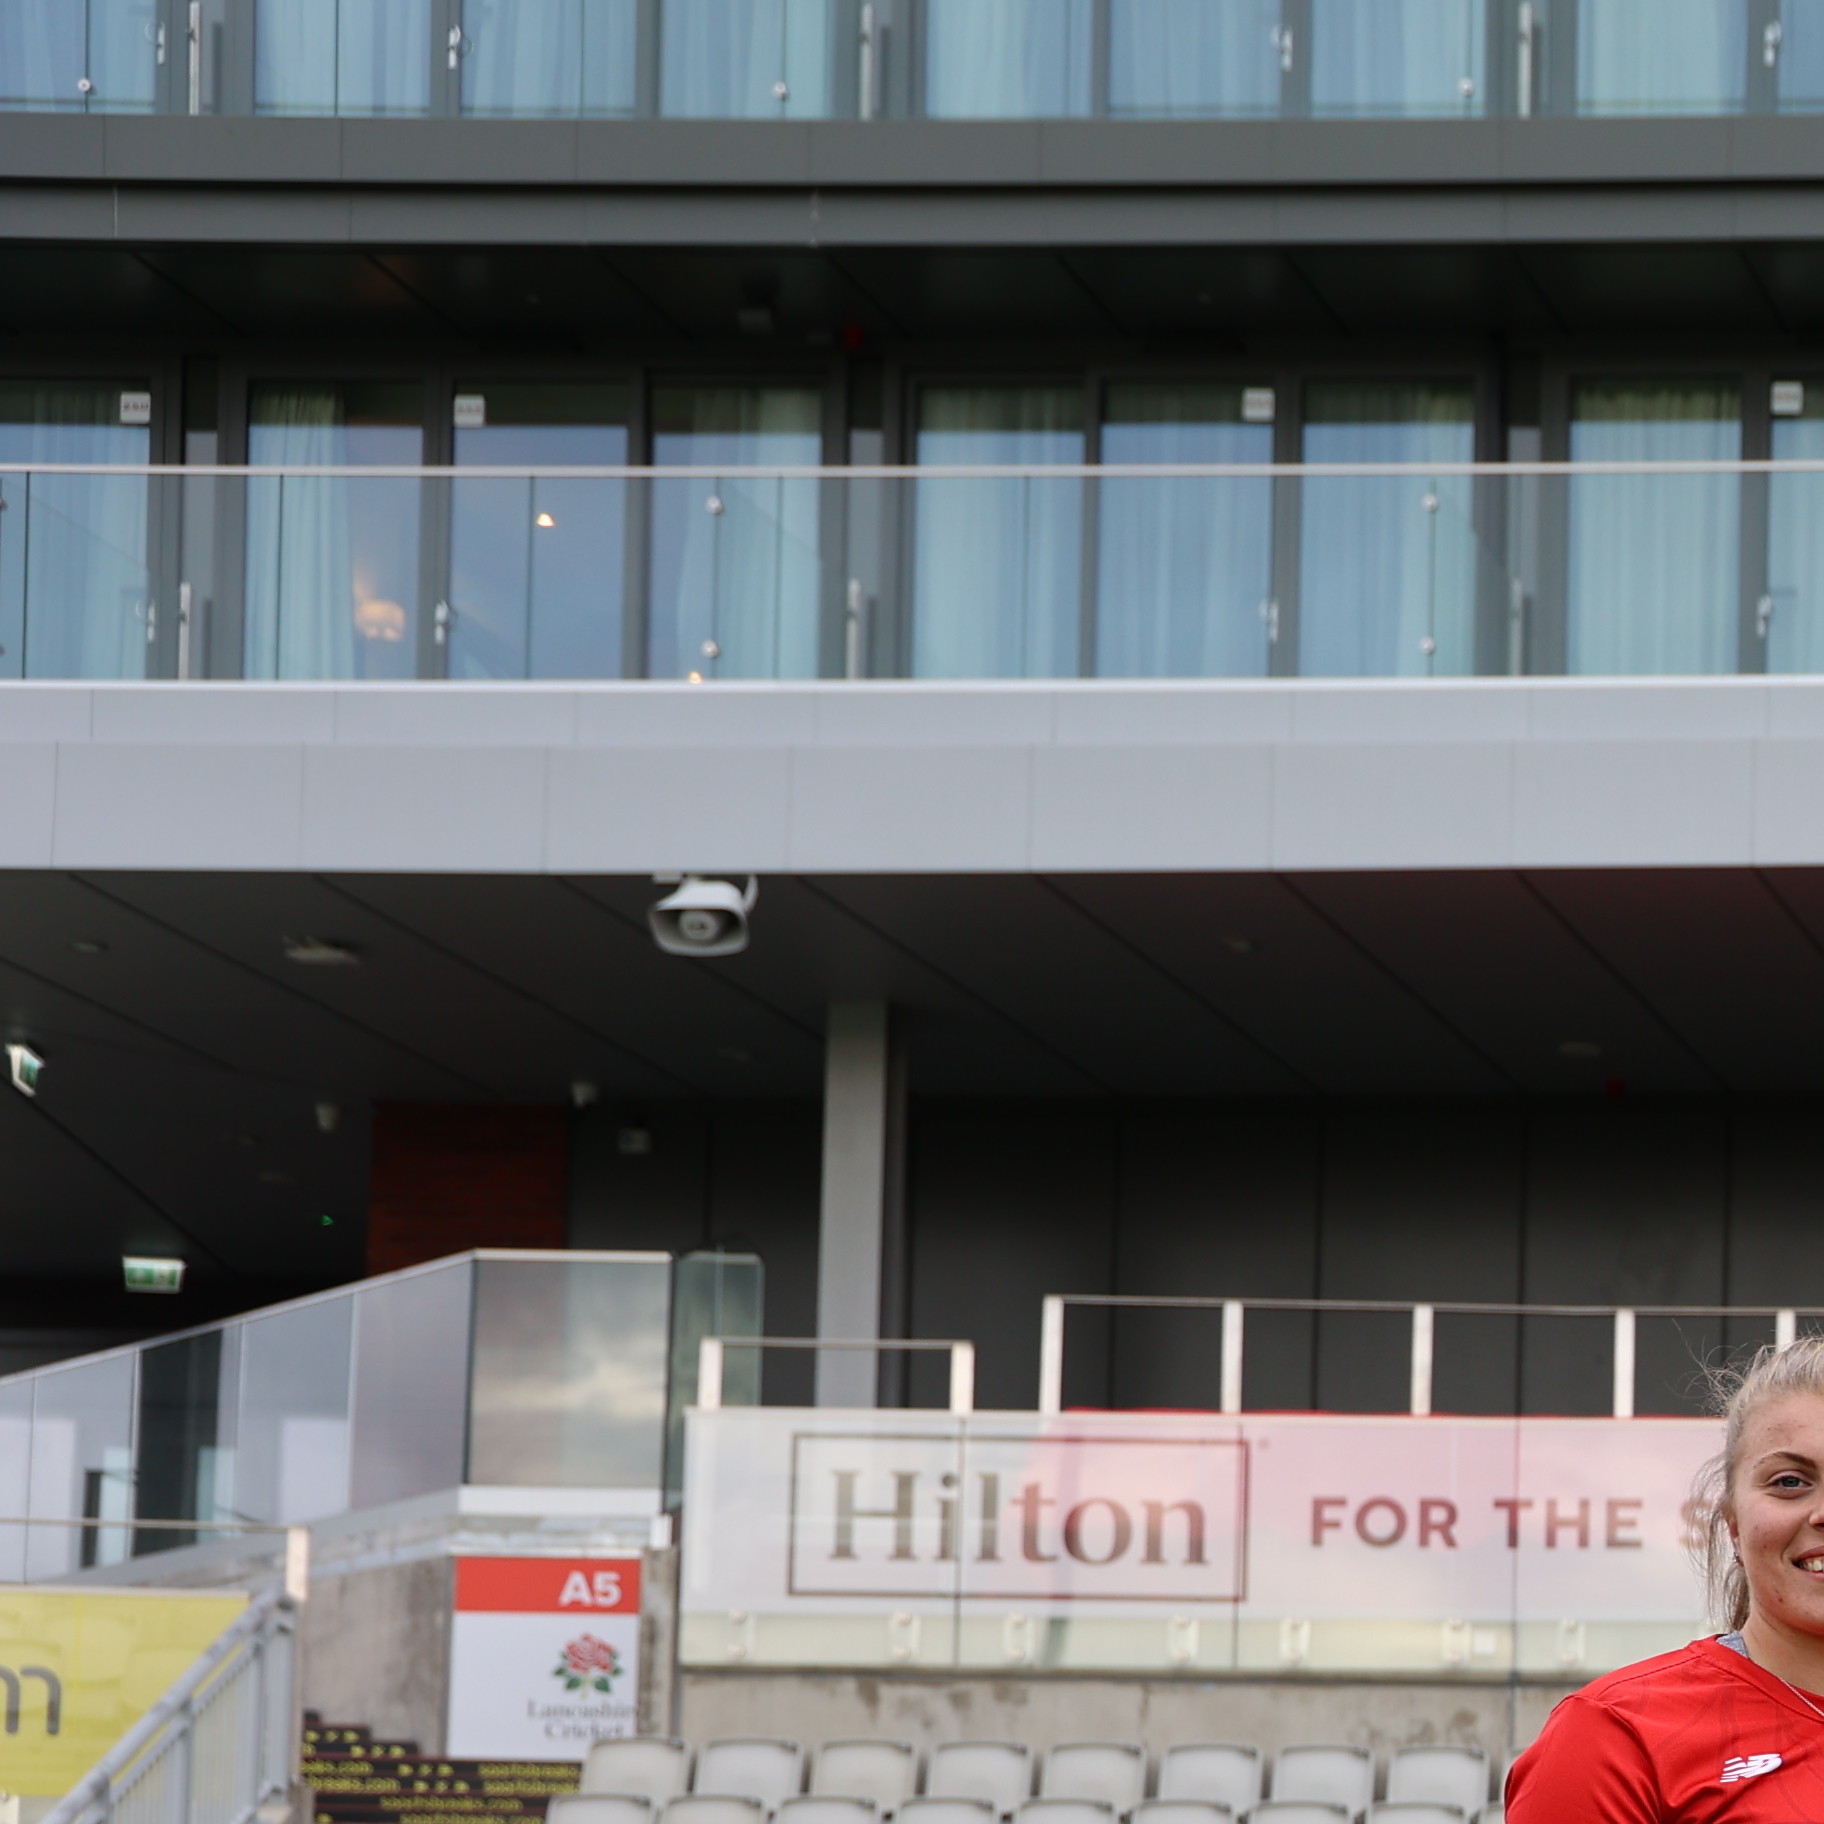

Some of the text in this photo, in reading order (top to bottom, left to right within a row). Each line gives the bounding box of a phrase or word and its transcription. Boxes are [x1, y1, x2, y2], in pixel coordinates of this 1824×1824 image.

[826, 1470, 1209, 1567] Hilton
[1311, 1497, 1459, 1549] FOR
[1493, 1498, 1643, 1550] THE
[558, 1569, 622, 1608] A5
